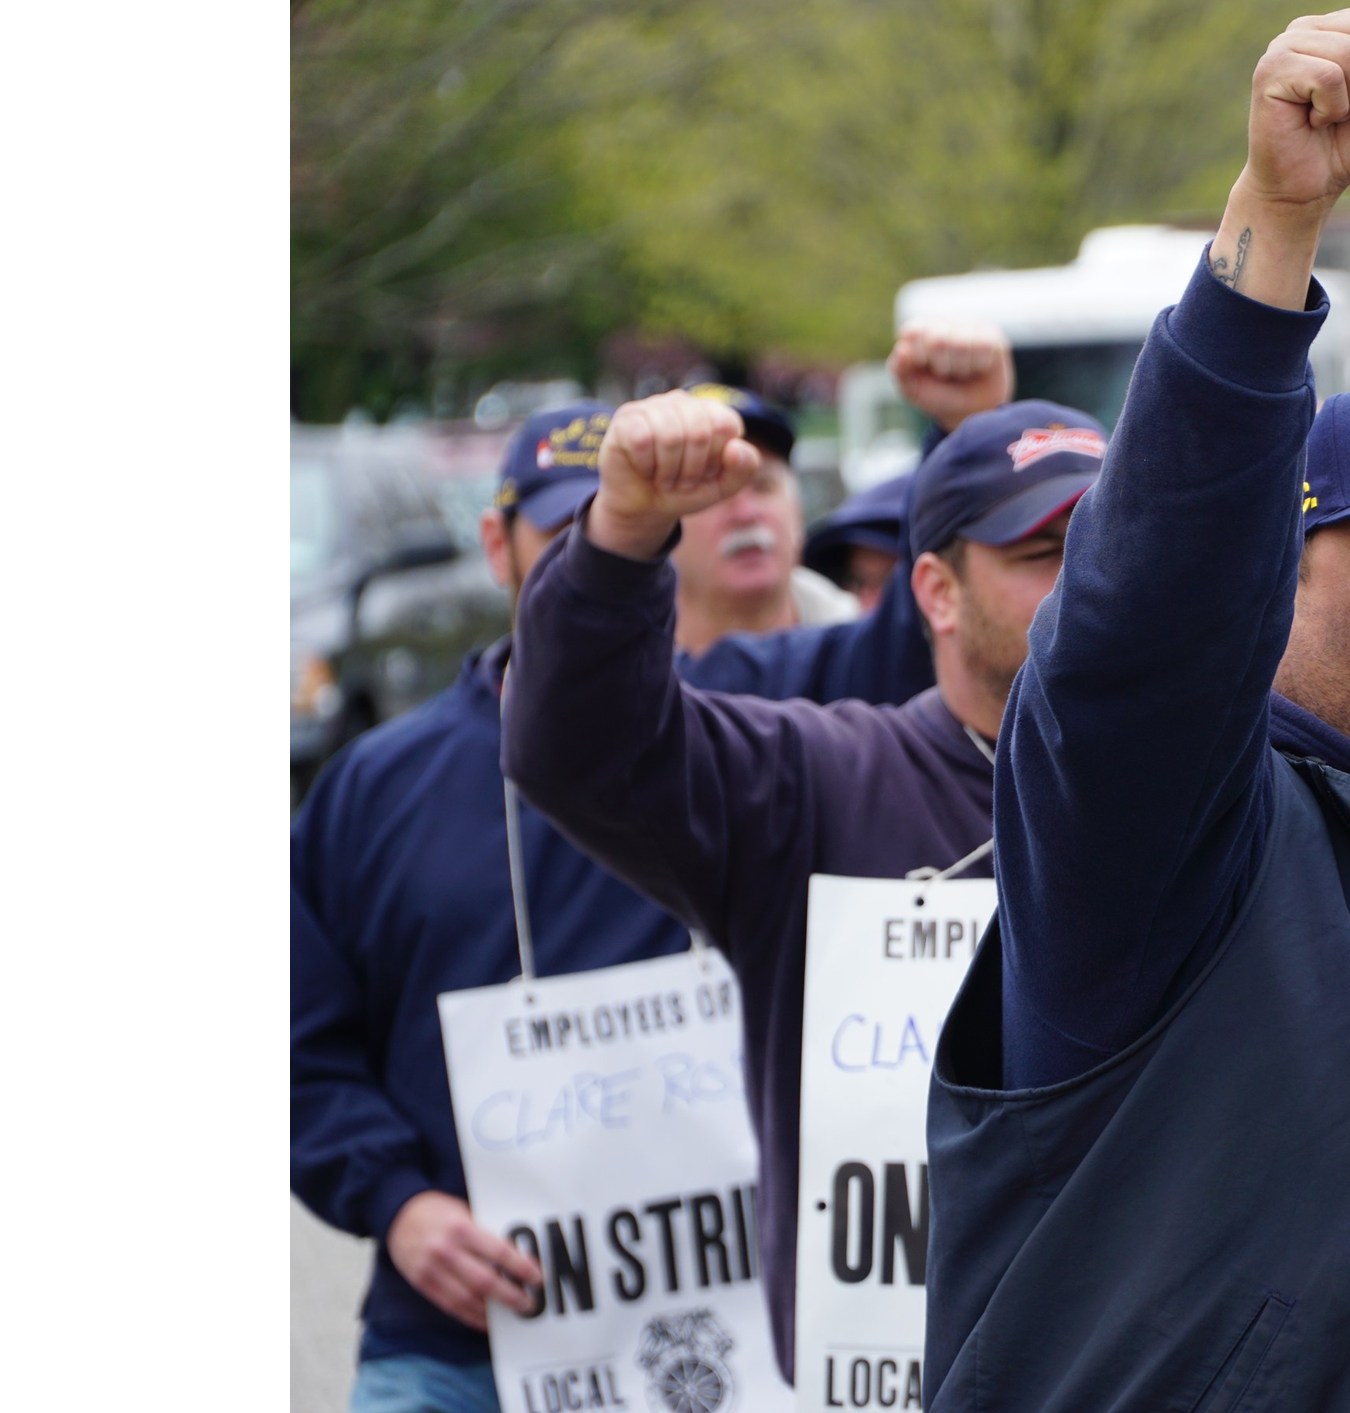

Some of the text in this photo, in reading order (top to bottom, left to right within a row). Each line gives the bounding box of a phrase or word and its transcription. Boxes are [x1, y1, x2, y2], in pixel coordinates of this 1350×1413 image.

[506, 994, 685, 1056] EMPLOYEES
[831, 1012, 945, 1072] CLA
[607, 1185, 758, 1302] STRI
[832, 1161, 931, 1286] ON
[522, 1361, 626, 1413] LOCAL
